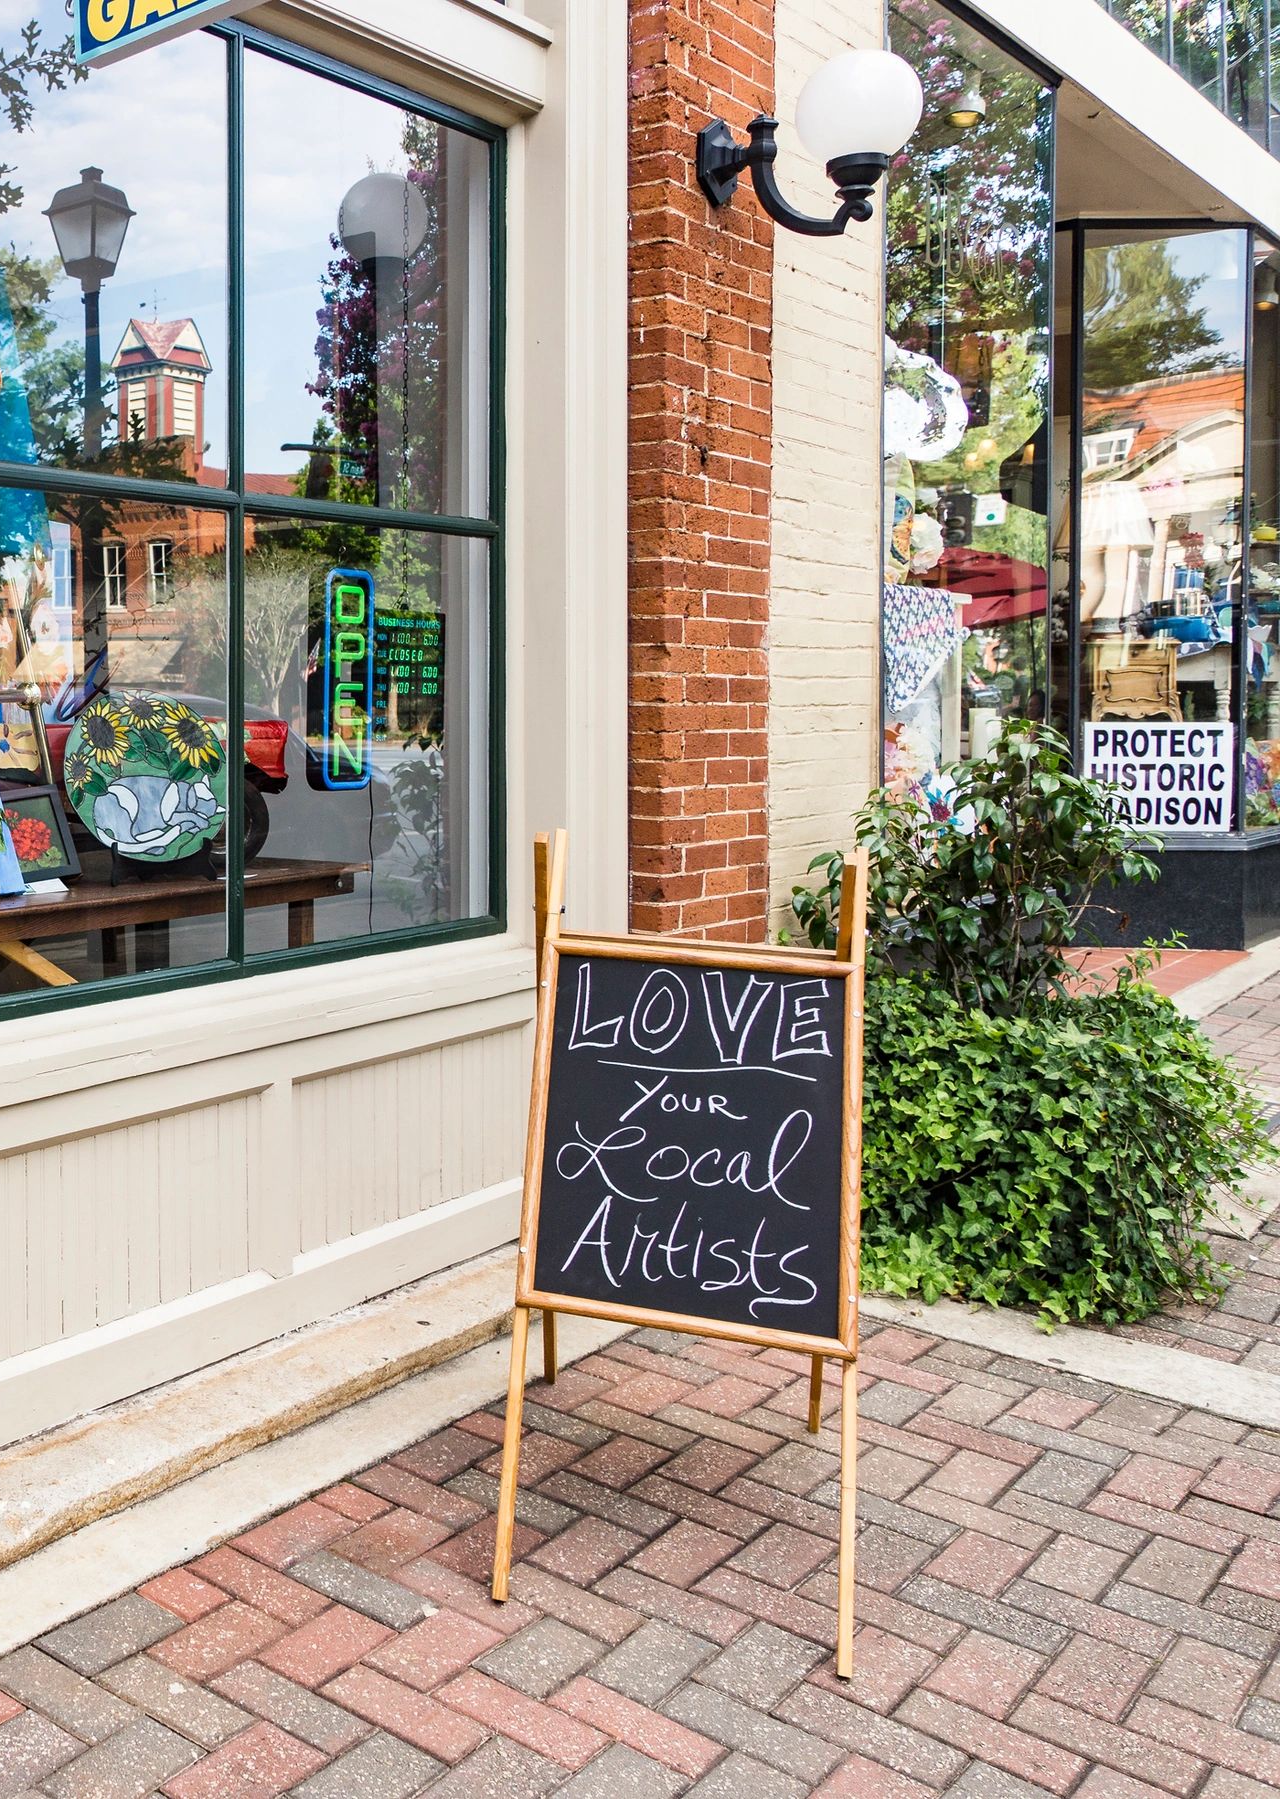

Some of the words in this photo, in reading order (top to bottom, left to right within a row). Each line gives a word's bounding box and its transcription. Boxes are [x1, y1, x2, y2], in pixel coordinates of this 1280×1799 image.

[87, 0, 200, 42] GA
[378, 616, 414, 628] BUSINESS
[416, 620, 441, 630] HOURS
[389, 648, 423, 662] CLOSED
[333, 585, 365, 777] OPEN
[376, 683, 387, 691] THU
[376, 700, 387, 709] FRI
[375, 717, 387, 725] SAT
[1093, 729, 1224, 758] PROTECT
[1091, 763, 1225, 792] HISTORIC
[569, 962, 833, 1065] LOVE
[619, 1075, 748, 1122] YOUR
[556, 1109, 813, 1210] Local
[561, 1195, 818, 1319] Artists
